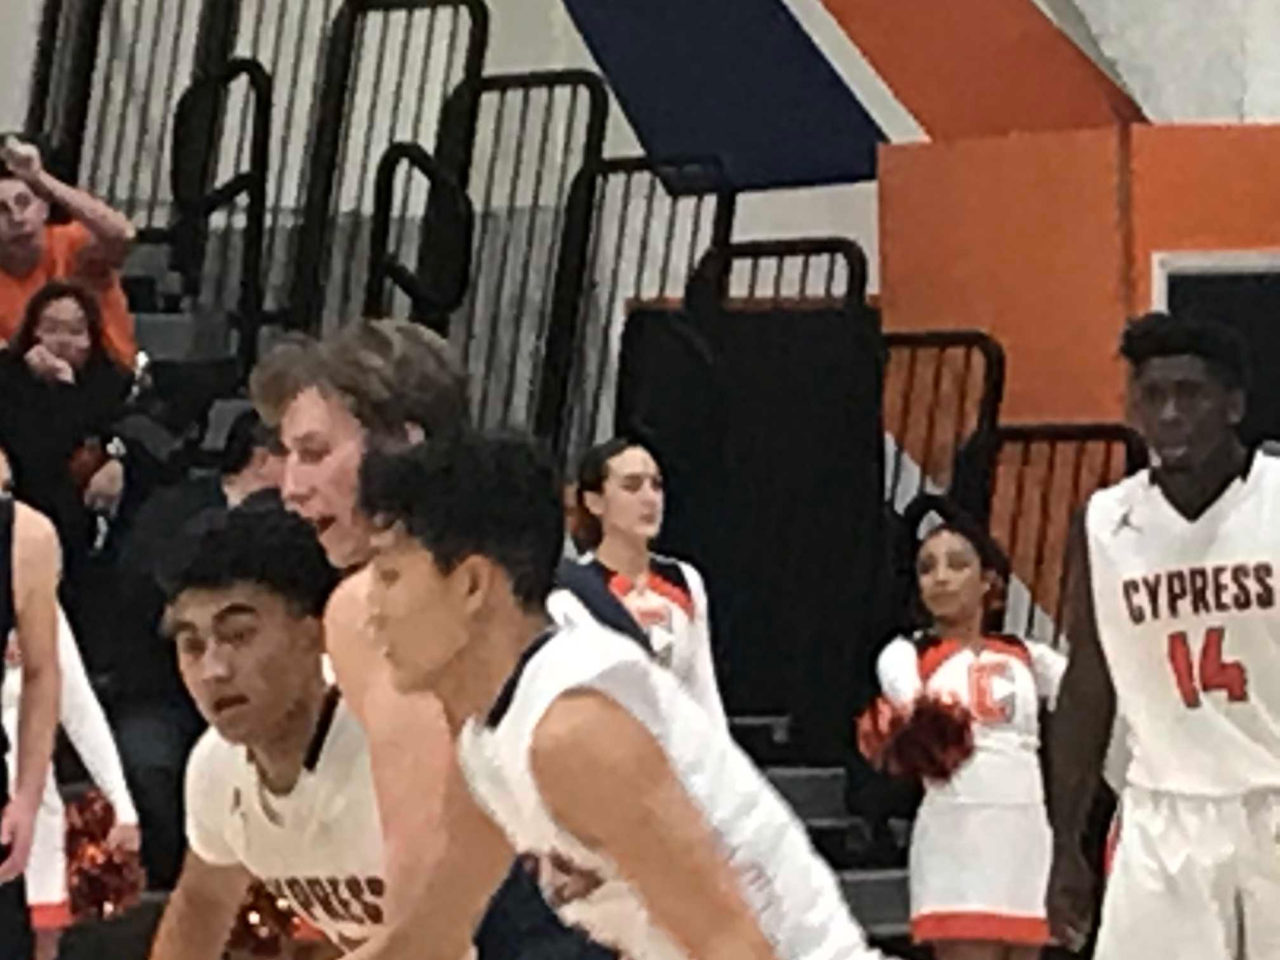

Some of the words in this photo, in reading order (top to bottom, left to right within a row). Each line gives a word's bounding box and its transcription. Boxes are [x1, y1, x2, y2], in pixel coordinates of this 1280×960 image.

[1123, 562, 1275, 625] CYPRESS
[967, 660, 1015, 725] C
[1167, 625, 1249, 708] 14
